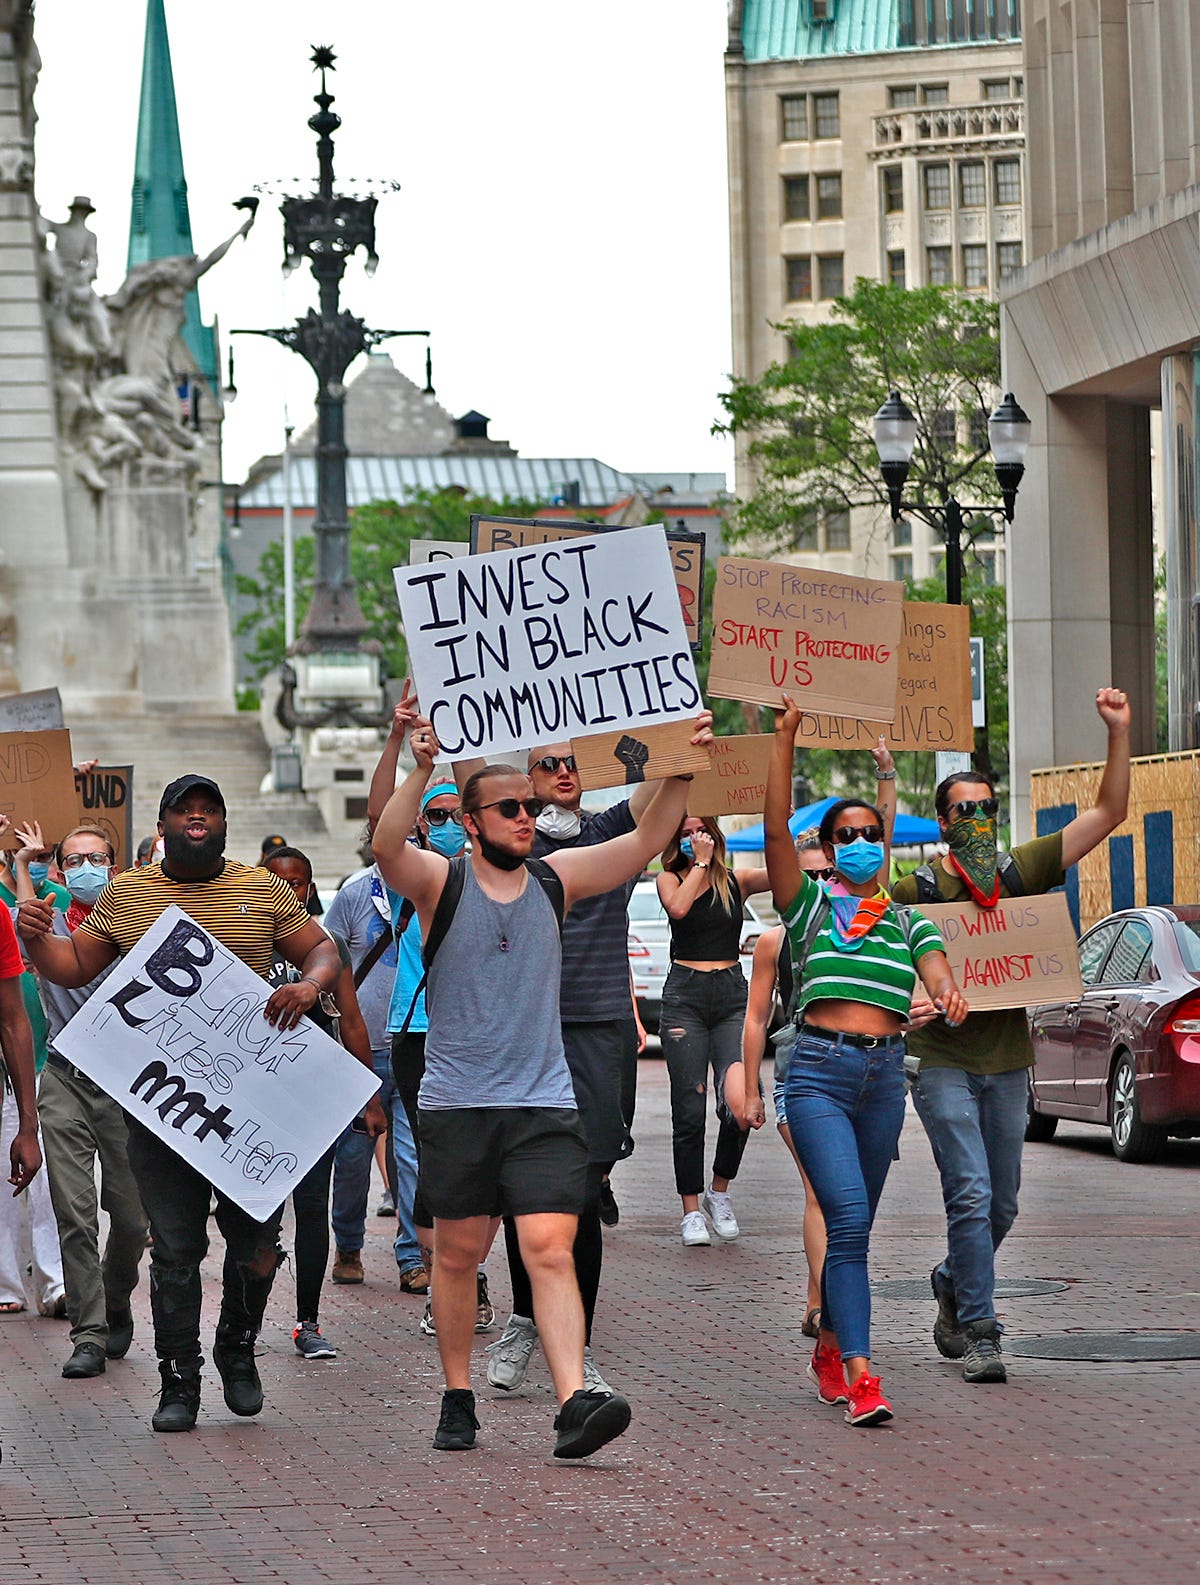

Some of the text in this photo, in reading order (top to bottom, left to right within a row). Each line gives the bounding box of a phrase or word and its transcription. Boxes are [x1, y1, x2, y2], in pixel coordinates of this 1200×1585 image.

[407, 544, 596, 631] INVEST
[723, 564, 887, 605] STOP PROTECTING
[756, 597, 847, 630] RACISM
[902, 610, 947, 648] lings
[434, 624, 509, 687] IN
[524, 591, 669, 670] BLACK
[719, 619, 891, 664] START PROTECTING
[770, 656, 813, 687] US
[429, 652, 700, 754] COMMUNITIES
[716, 759, 750, 777] LIVES
[74, 773, 126, 809] FUND
[960, 909, 1008, 937] WITH
[1010, 907, 1040, 928] US
[962, 953, 1064, 989] AGAINST US
